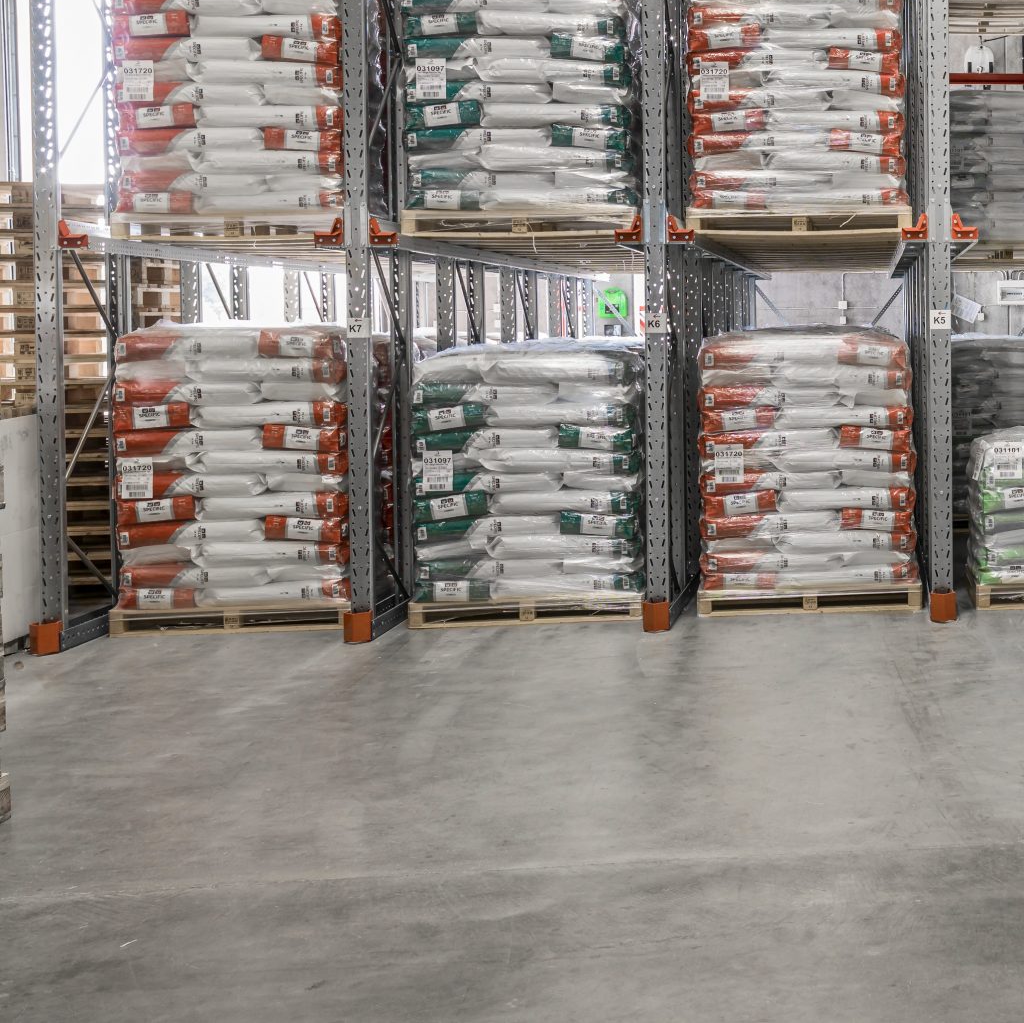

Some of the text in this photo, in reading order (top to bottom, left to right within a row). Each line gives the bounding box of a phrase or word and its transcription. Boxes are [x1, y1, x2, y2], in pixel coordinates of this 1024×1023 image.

[647, 320, 661, 328] K6
[933, 316, 947, 325] K5
[349, 324, 362, 333] K7
